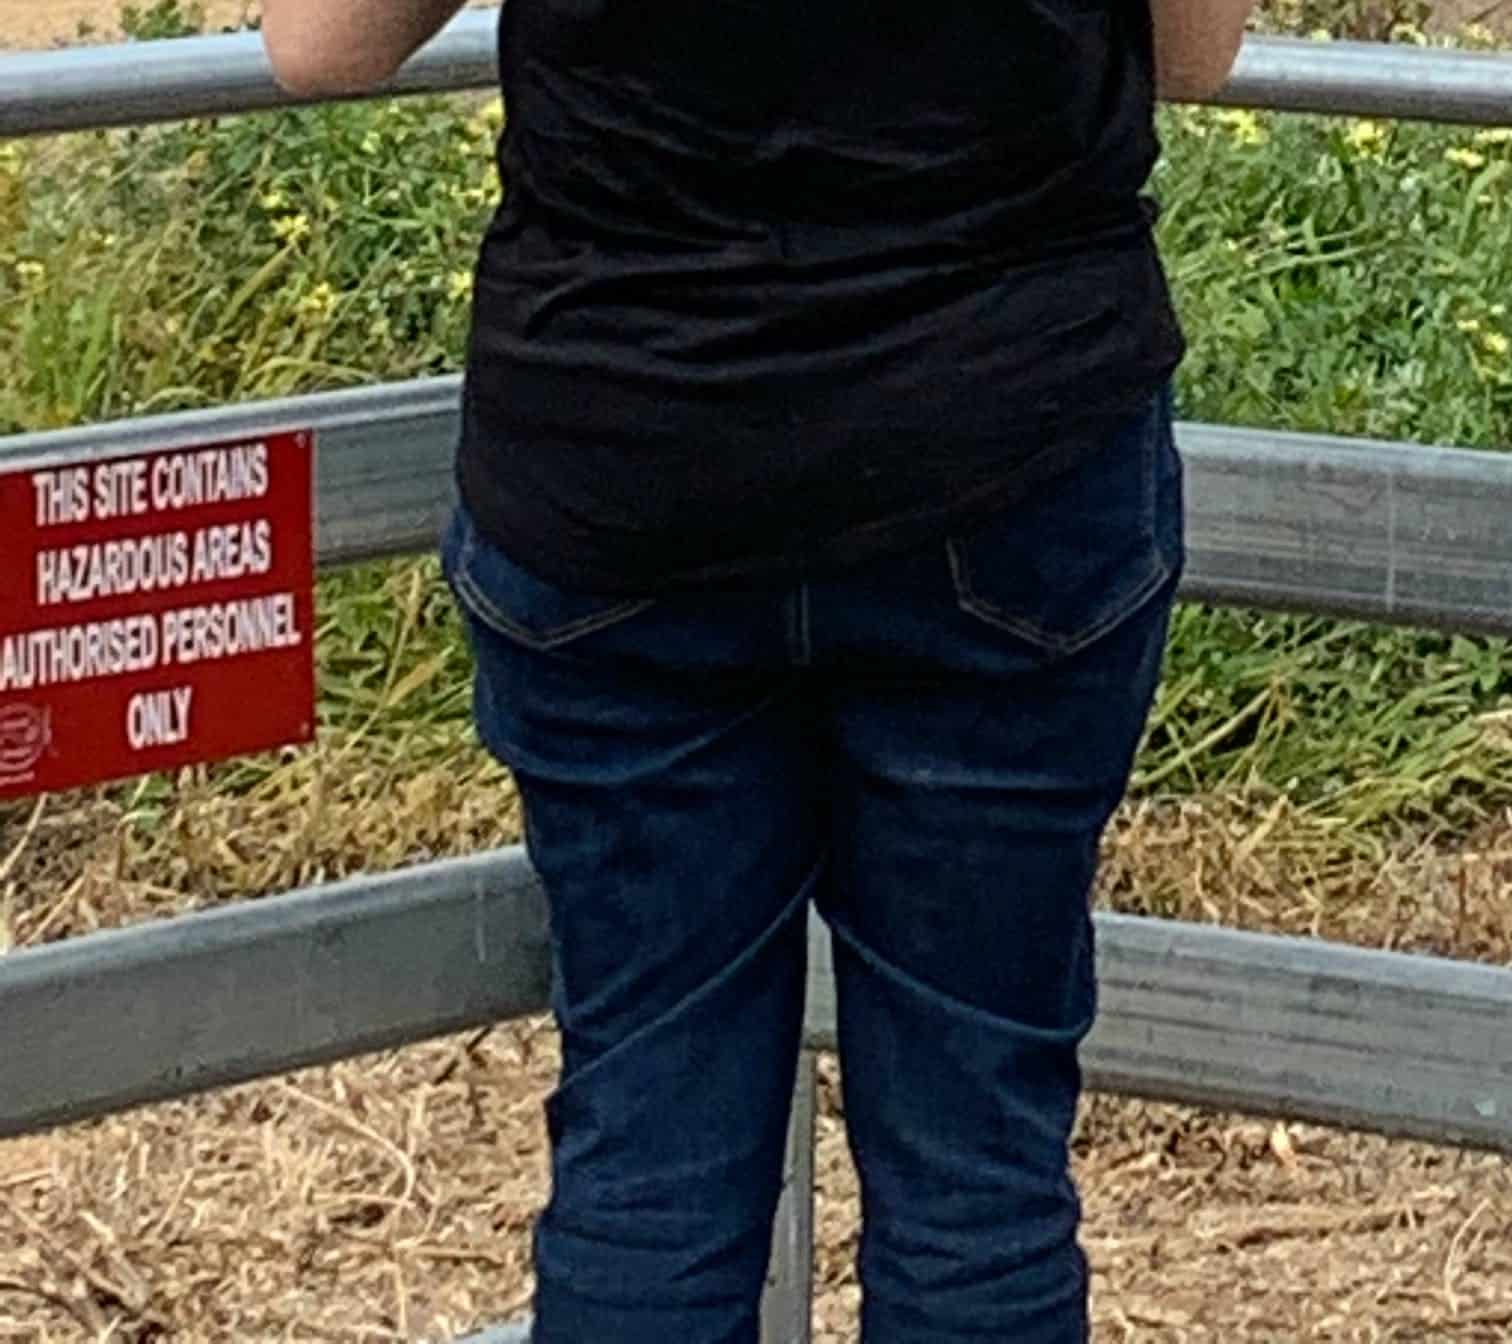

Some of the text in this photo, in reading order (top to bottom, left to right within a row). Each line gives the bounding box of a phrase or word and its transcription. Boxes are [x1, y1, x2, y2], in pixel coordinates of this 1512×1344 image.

[33, 443, 269, 527] THIS SITE CONTAINS
[37, 519, 271, 605] HAZARDOUS AREAS
[0, 593, 301, 690] AUTHORISED PERSONNEL
[127, 686, 192, 750] ONLY
